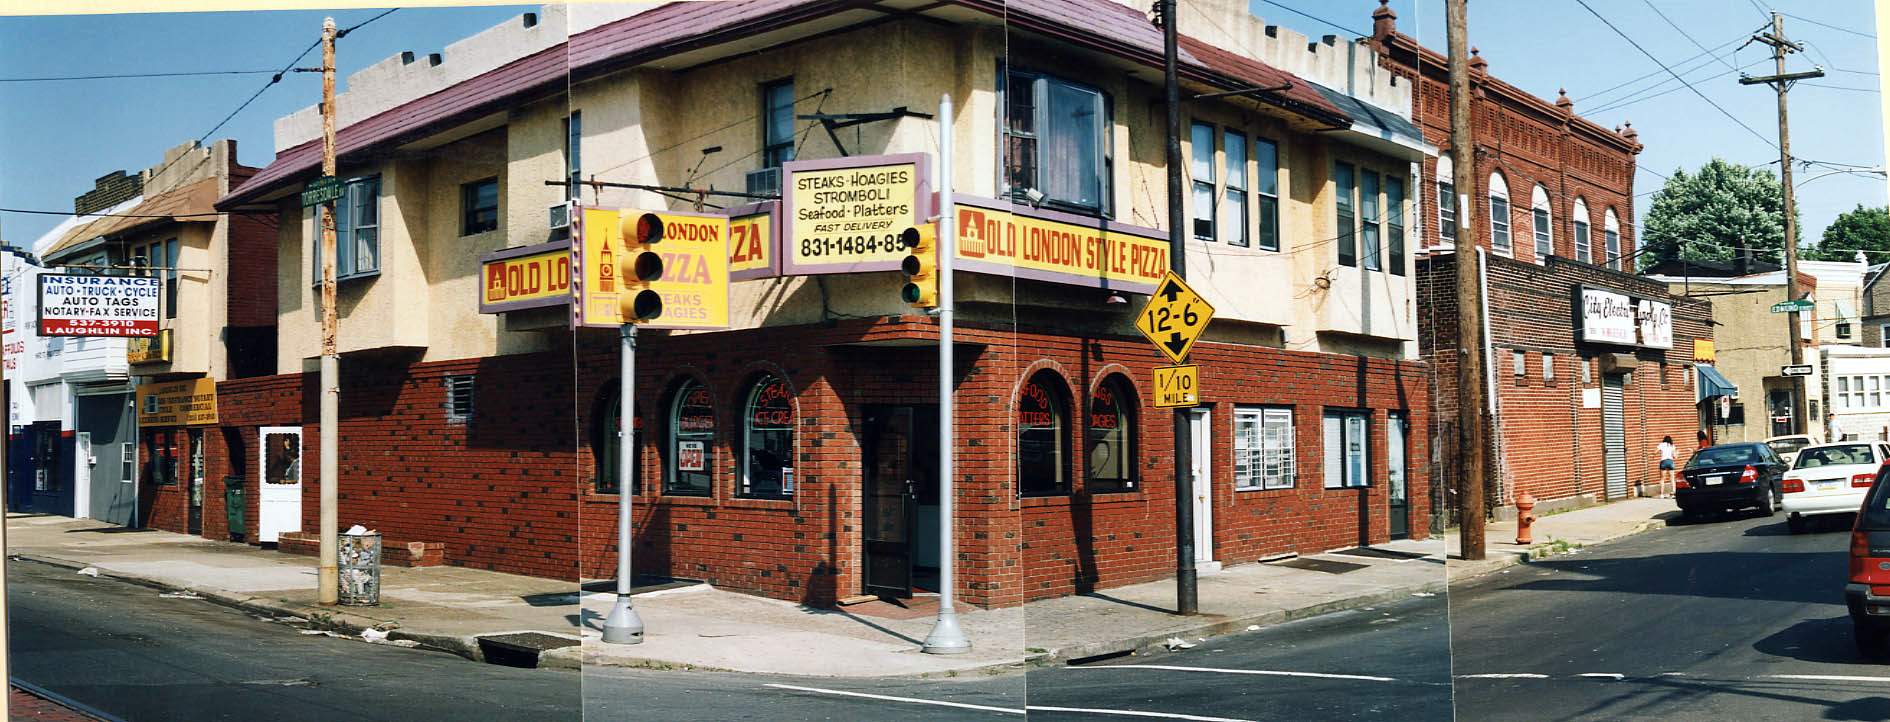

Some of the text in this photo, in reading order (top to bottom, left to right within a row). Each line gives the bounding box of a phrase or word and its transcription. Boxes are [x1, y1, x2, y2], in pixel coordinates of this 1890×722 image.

[798, 171, 908, 190] STEAKS HOAGIES
[814, 188, 890, 204] STROMBOLI
[799, 204, 909, 220] Seafood Platters
[814, 220, 893, 233] FAST DELIVERY
[986, 219, 1165, 279] OLD LONDON STYLE PIZZA
[661, 252, 713, 285] ZZA
[43, 276, 158, 286] INSURANCE
[508, 257, 569, 297] OLD LO
[46, 285, 157, 298] AUTO TRUCK CYCLE
[62, 296, 139, 307] AUTO TAGS
[662, 293, 702, 306] EAKS
[45, 306, 156, 318] NOTARY-FAX SERVICE
[663, 306, 707, 320] AGIES
[69, 319, 135, 327] 537-3910
[46, 327, 157, 336] LAUGHLIN INC.
[1160, 369, 1191, 392] 1/10
[1164, 392, 1188, 404] MILE
